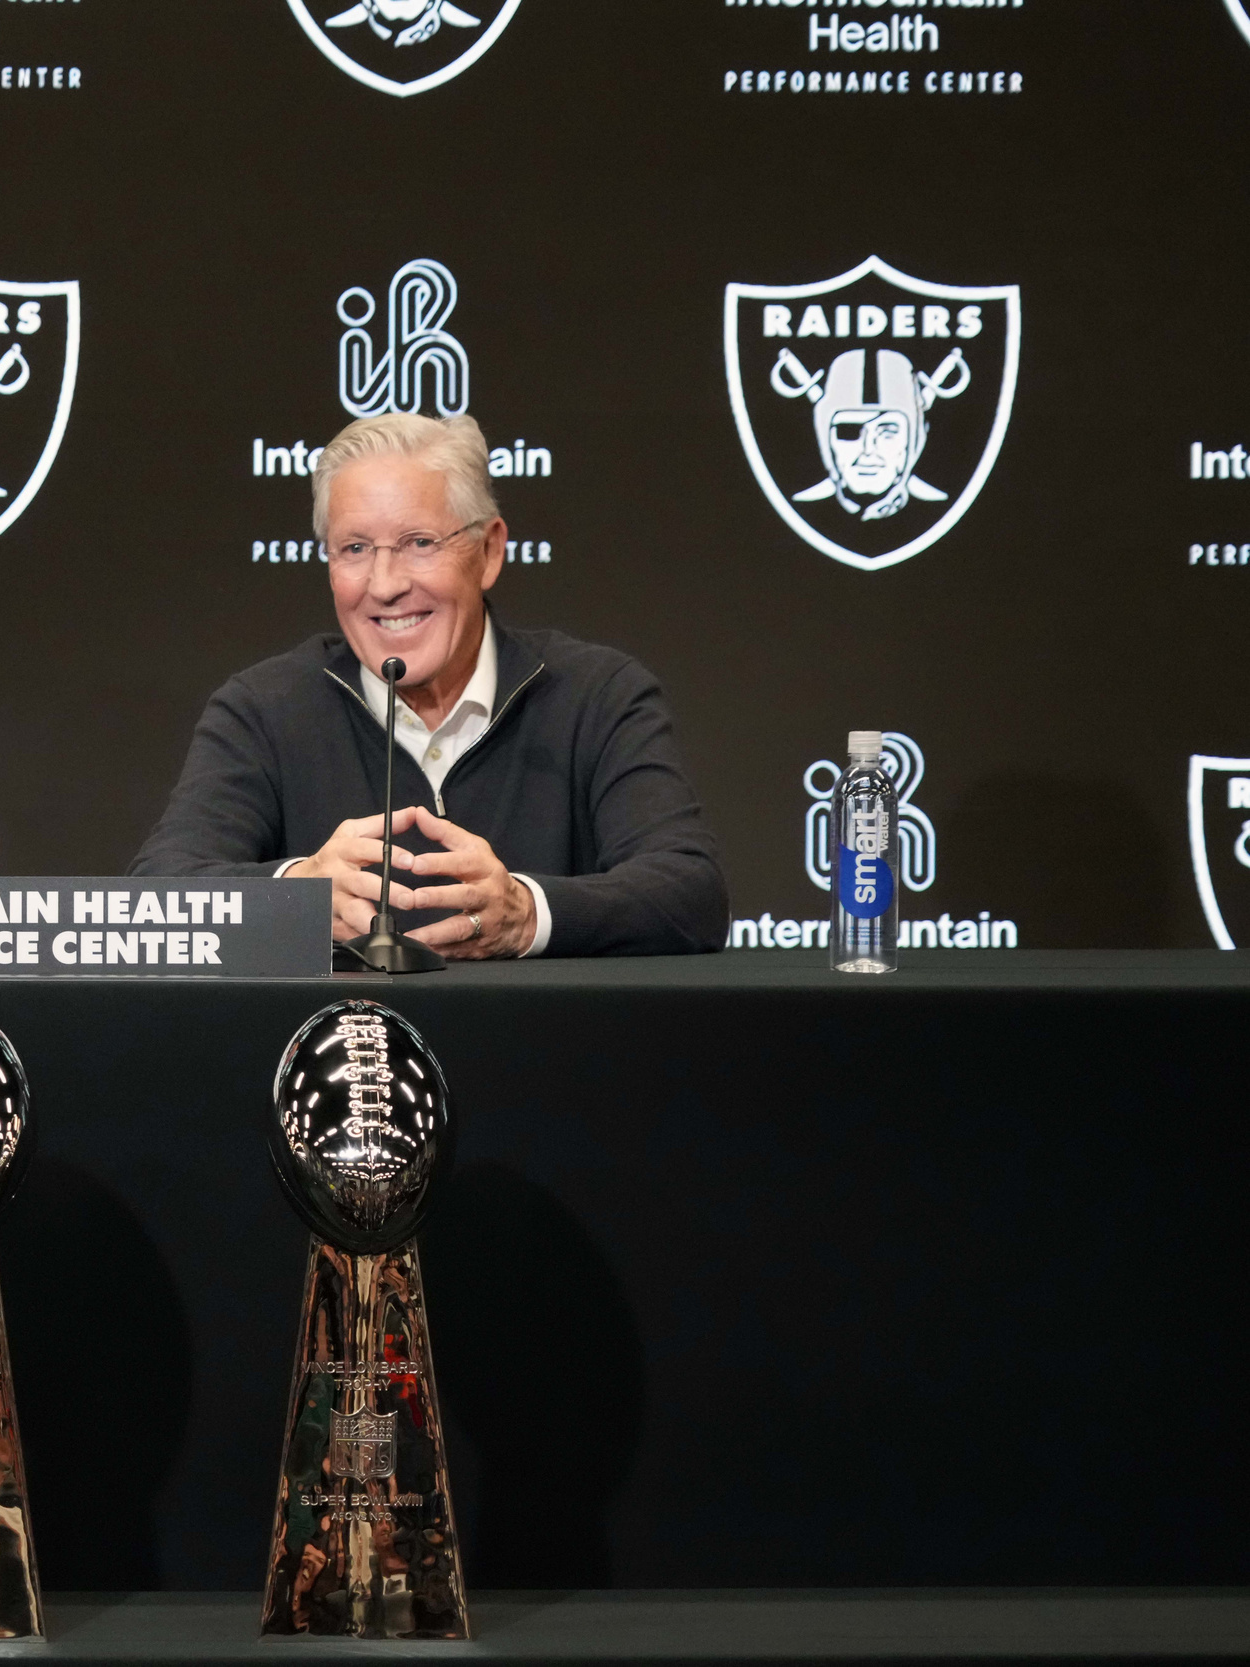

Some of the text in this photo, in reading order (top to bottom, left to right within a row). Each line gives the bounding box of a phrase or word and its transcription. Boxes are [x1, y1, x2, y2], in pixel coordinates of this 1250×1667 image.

[809, 13, 939, 53] Health
[724, 70, 1023, 93] PERFORMANCE CENTER
[763, 304, 984, 338] RAIDERS
[879, 811, 890, 851] water
[852, 808, 877, 905] smart
[75, 891, 243, 925] HEALTH
[51, 931, 223, 966] CENTER
[301, 1361, 423, 1374] VINCE LOMBARDI
[334, 1379, 392, 1392] TROPHY
[300, 1495, 424, 1507] SUPER BOWL XVIII
[331, 1511, 352, 1521] AFC
[370, 1512, 392, 1521] NFC
